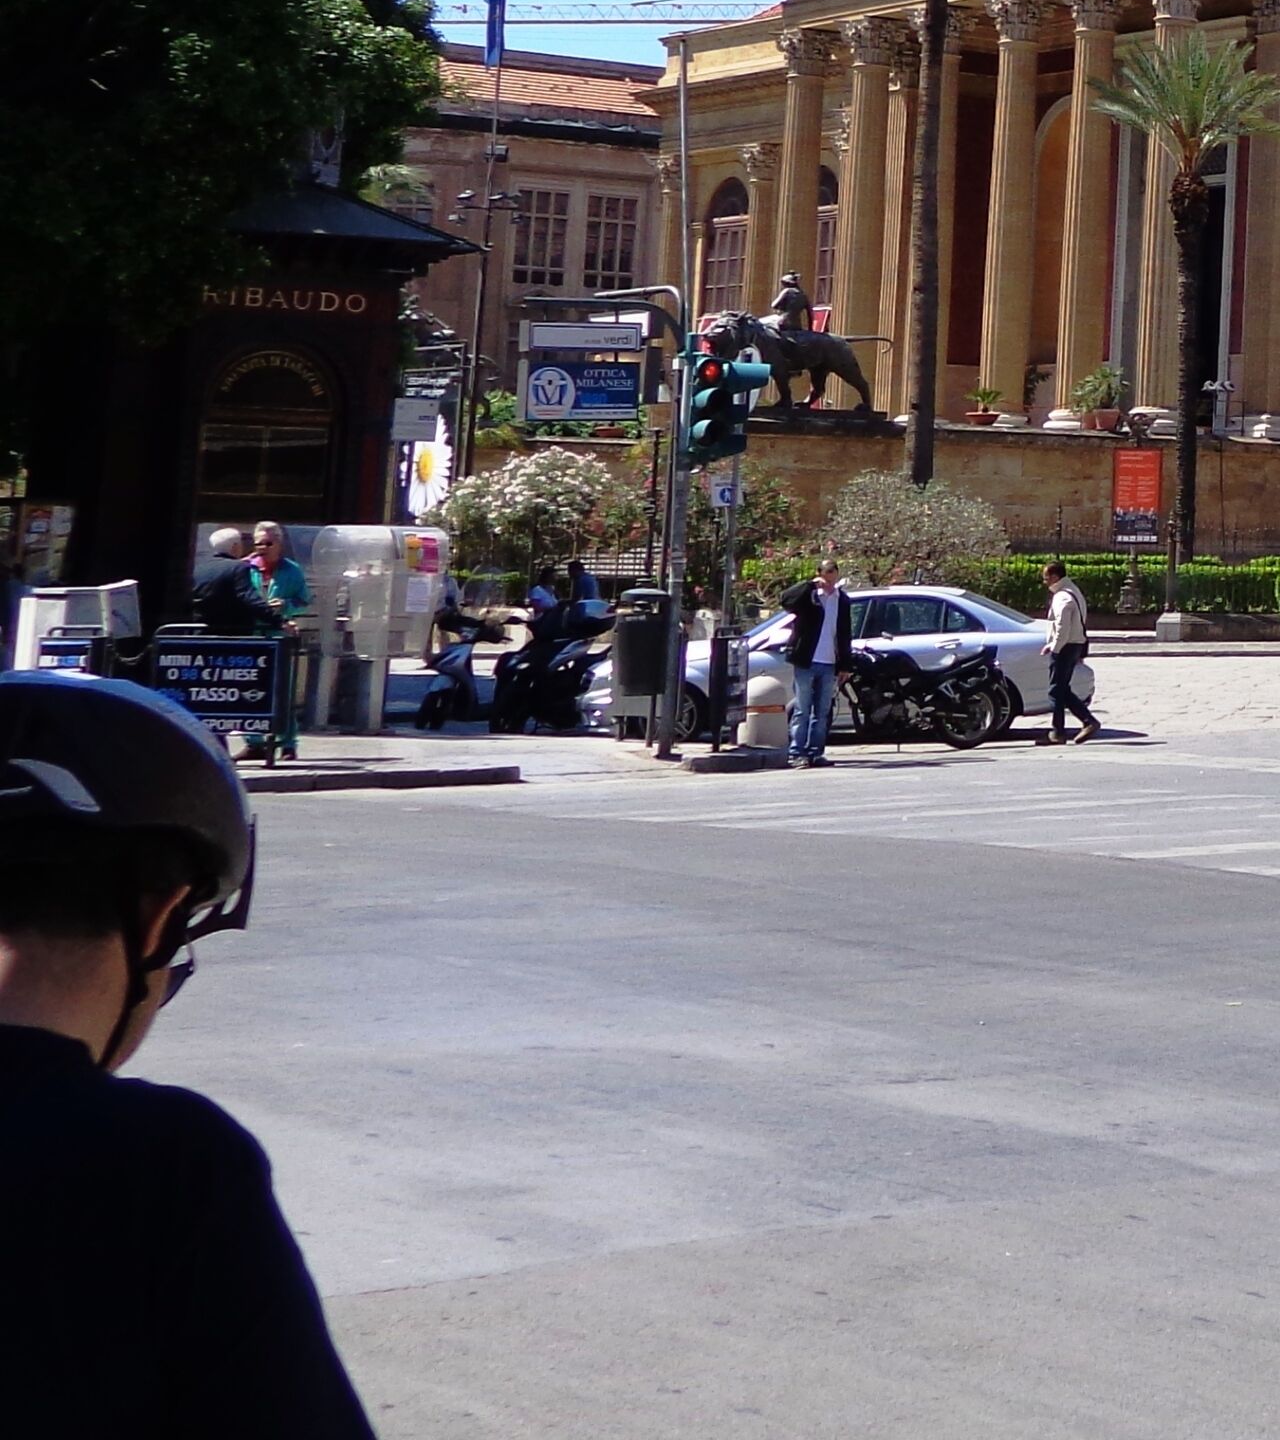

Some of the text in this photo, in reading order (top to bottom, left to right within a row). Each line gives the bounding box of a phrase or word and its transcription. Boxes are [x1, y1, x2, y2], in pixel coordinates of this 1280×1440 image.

[202, 285, 367, 313] RIBAUDO
[583, 368, 626, 378] OTTICA
[576, 379, 634, 388] MILANESE
[159, 655, 192, 666] MINI
[193, 655, 204, 666] A
[257, 656, 267, 667] €
[202, 669, 212, 680] €
[222, 668, 259, 680] MESE
[189, 688, 240, 702] TASSO
[245, 720, 270, 731] CAR
